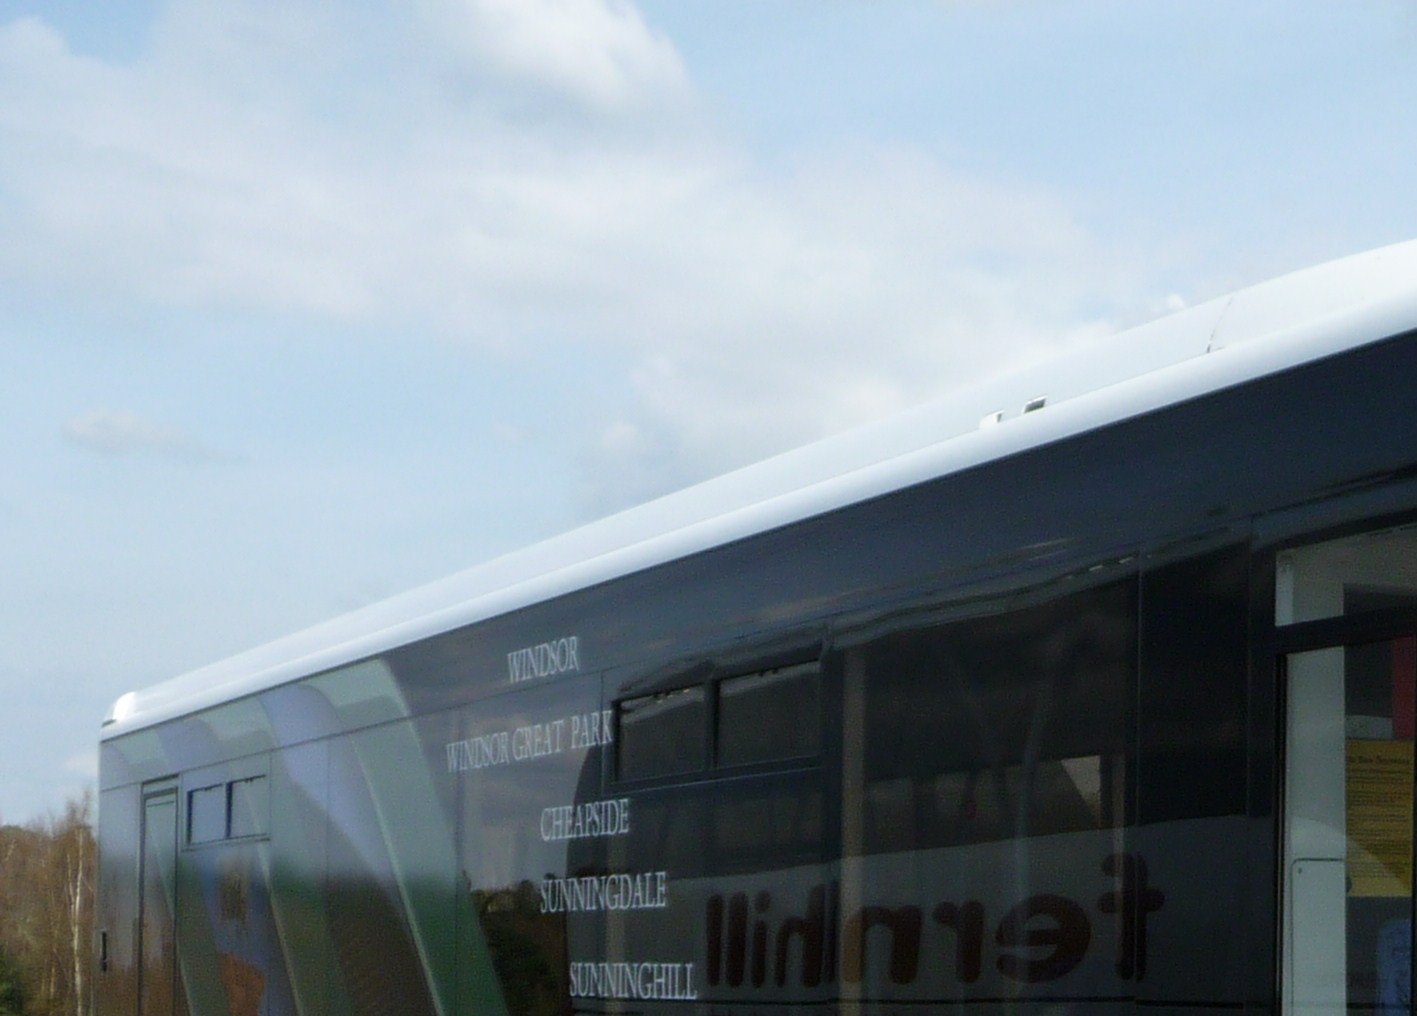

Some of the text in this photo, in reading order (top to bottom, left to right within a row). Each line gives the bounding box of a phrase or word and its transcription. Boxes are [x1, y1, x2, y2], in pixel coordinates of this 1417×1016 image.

[507, 636, 580, 684] WINDSOR
[446, 710, 613, 772] WINDSOR GREAT PARK
[540, 798, 630, 841] CHEAPSIDE
[540, 872, 667, 913] SUNNINGDALE
[569, 962, 698, 1000] SUNNINGHILL
